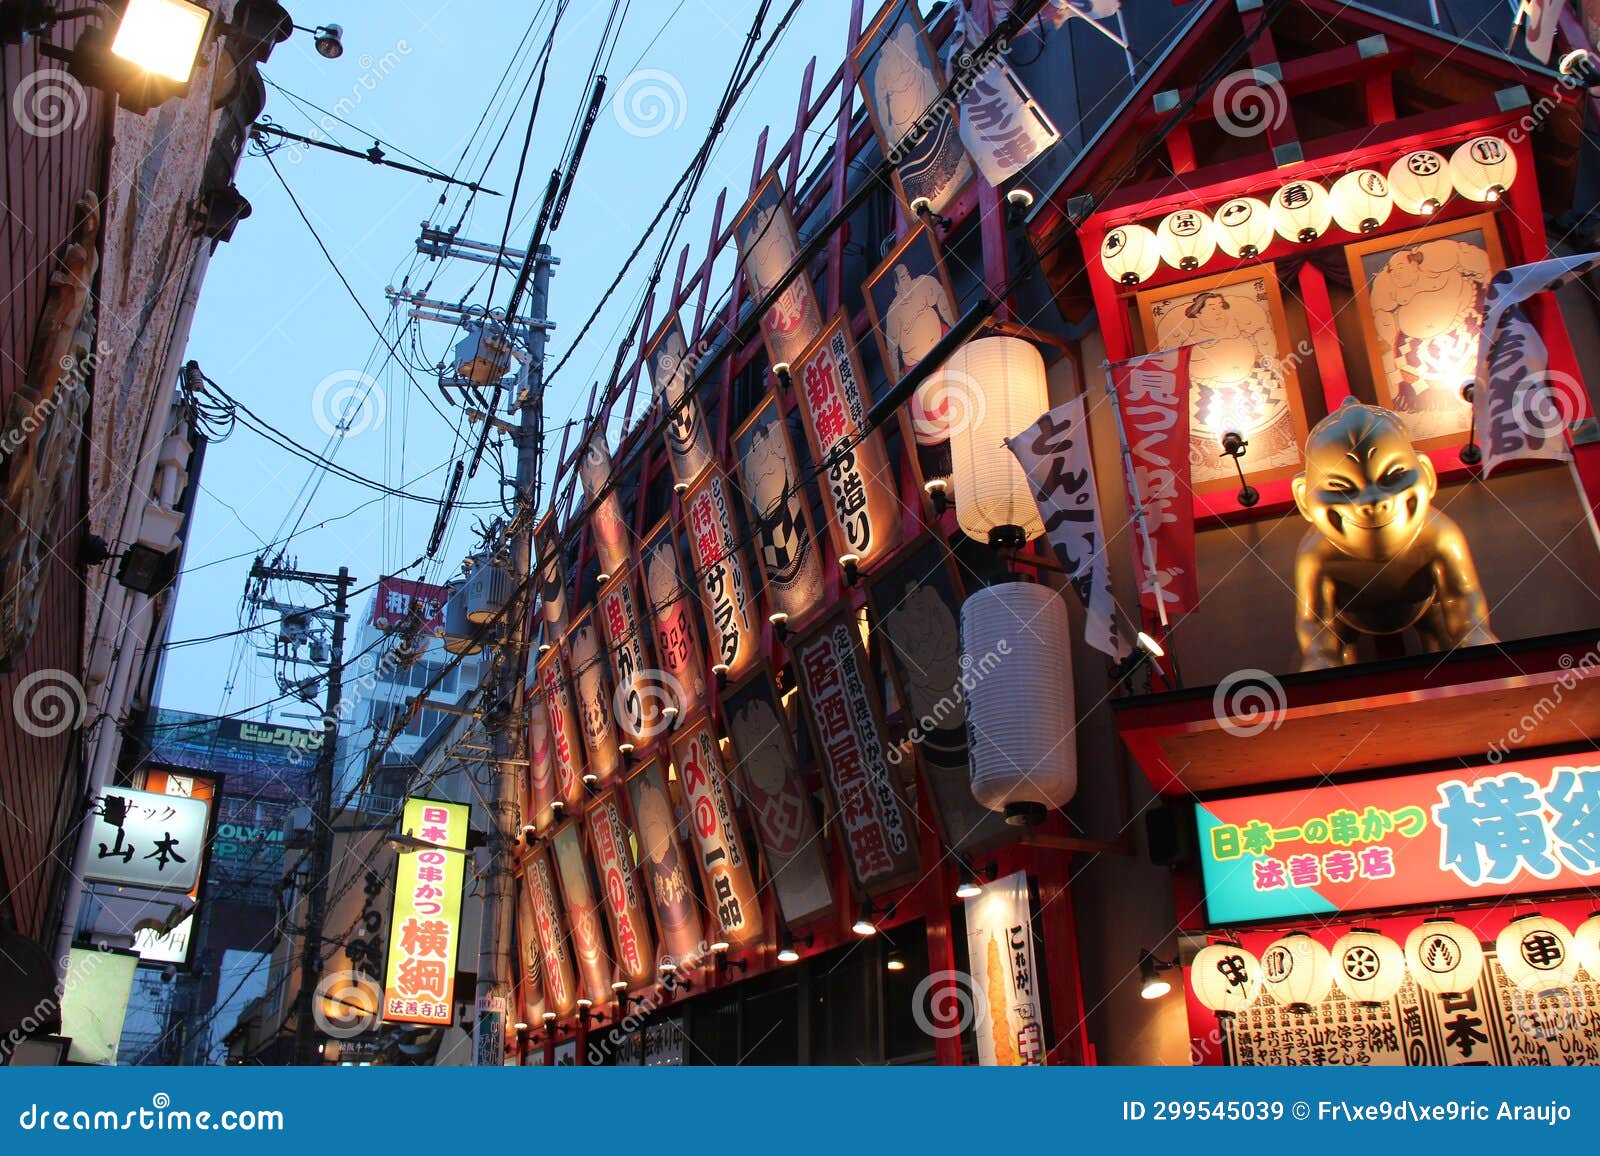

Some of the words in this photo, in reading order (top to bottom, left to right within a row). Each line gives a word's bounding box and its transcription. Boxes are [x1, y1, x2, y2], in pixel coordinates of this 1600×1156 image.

[804, 350, 870, 552] 新鮮お造り
[691, 492, 740, 666] 特製サラダ
[606, 591, 643, 736] 串かつ
[544, 666, 576, 800] ホルモン
[803, 638, 893, 881] 居酒屋料理
[122, 798, 177, 822] ナック
[700, 733, 741, 866] 飲んだ後には
[1211, 805, 1427, 861] 日本一の串かつ
[97, 828, 187, 871] 山本
[413, 806, 448, 916] 日本の串かつ
[1254, 846, 1396, 892] 法善寺店
[397, 916, 450, 999] 横綱
[1010, 925, 1030, 996] これが、
[1521, 931, 1564, 970] 串
[389, 1000, 448, 1019] 法善寺店
